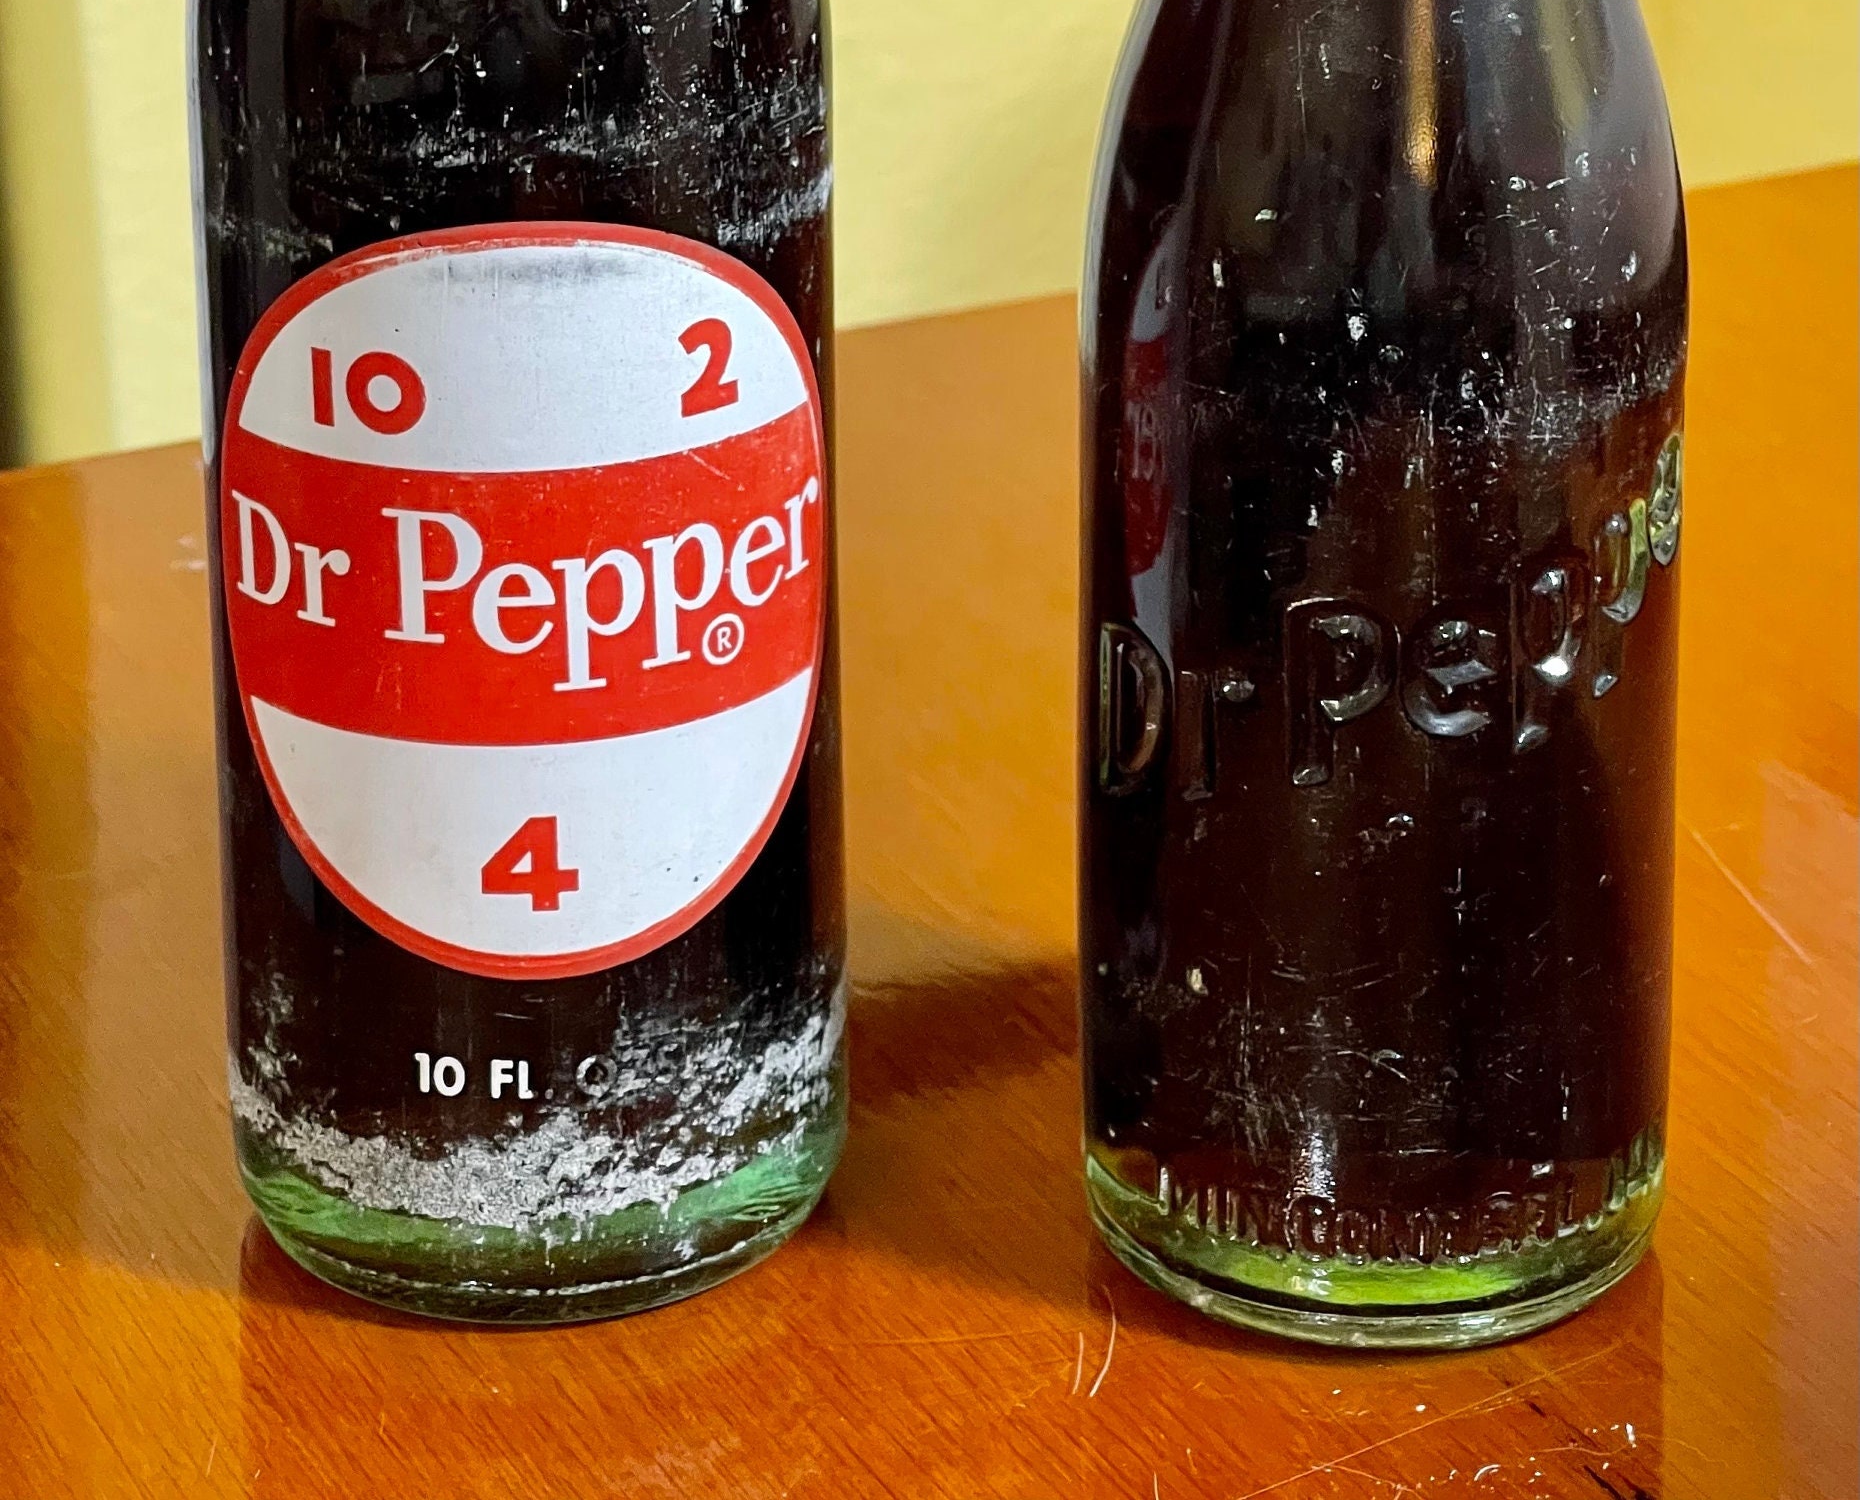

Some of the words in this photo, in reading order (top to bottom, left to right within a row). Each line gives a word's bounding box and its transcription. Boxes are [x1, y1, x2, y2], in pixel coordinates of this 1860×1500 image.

[310, 345, 426, 435] 10
[678, 318, 739, 418] 2
[231, 488, 351, 628] Dr
[382, 475, 819, 692] Pepper
[1099, 620, 1256, 798] Dr
[481, 816, 579, 912] 4
[414, 1052, 466, 1097] 10
